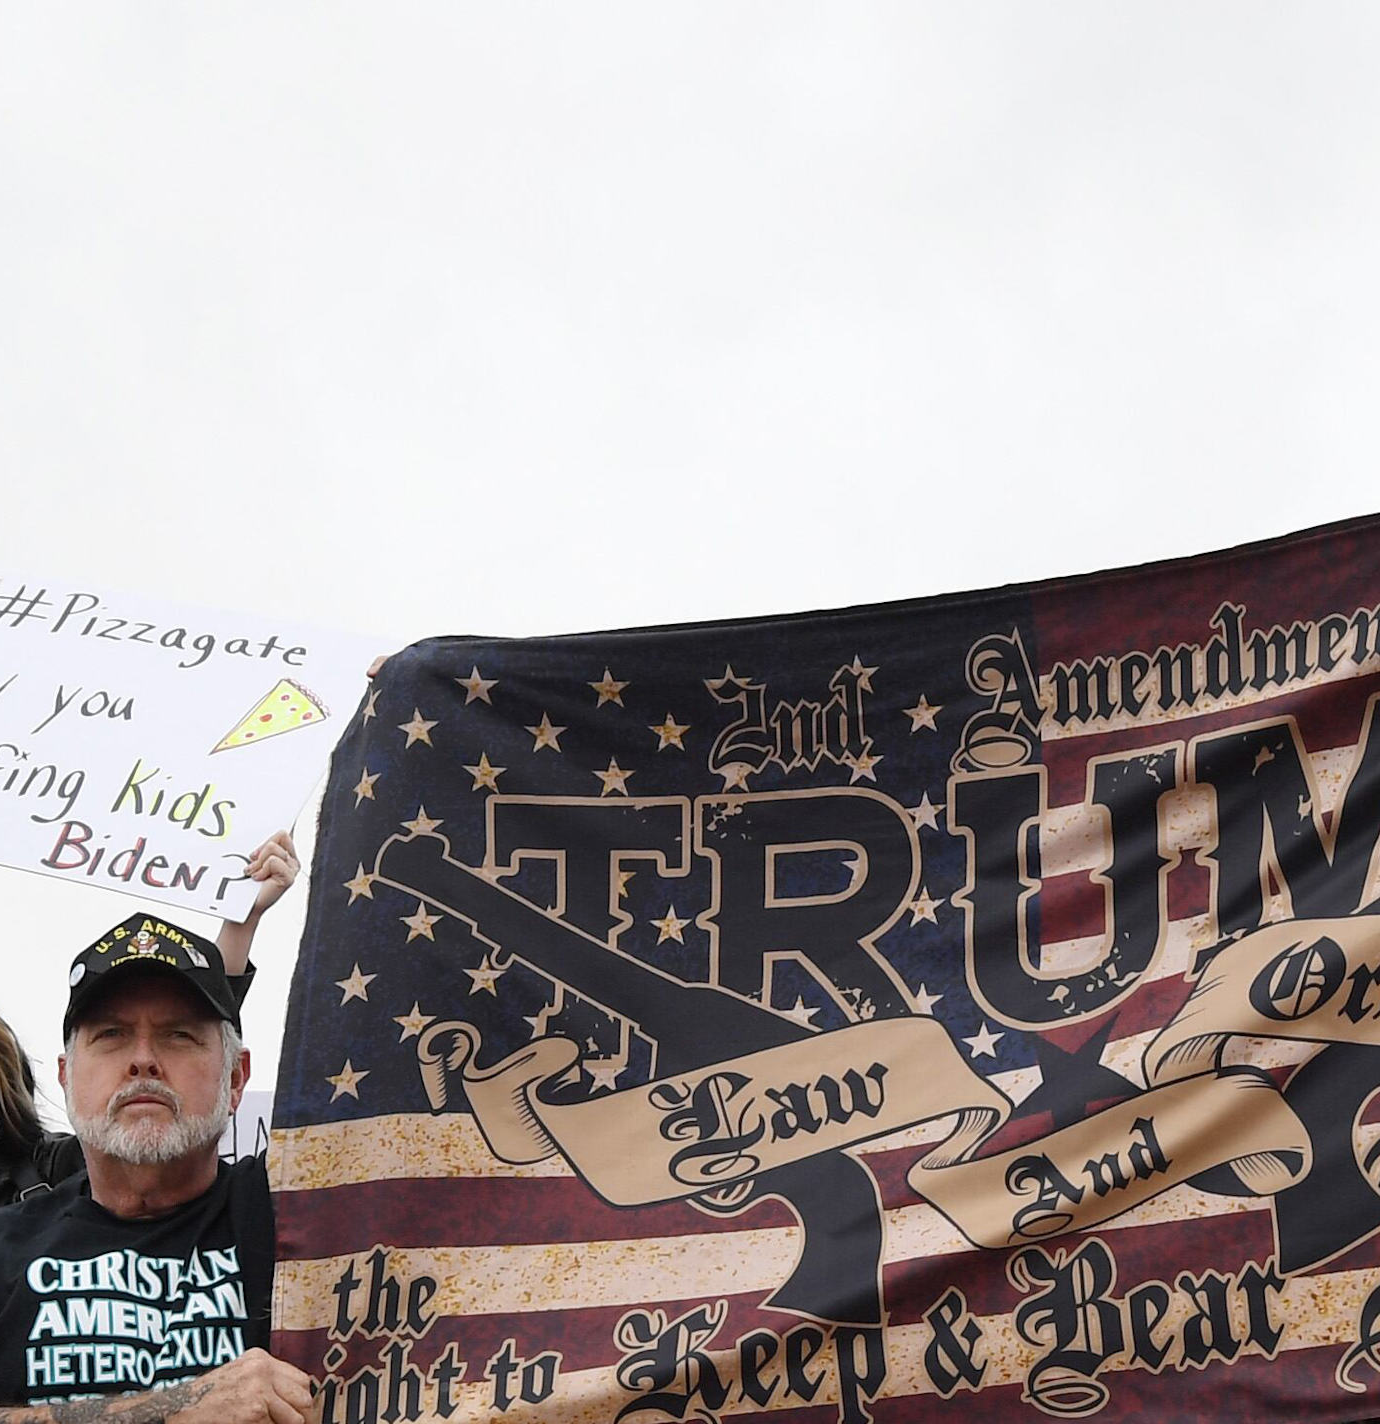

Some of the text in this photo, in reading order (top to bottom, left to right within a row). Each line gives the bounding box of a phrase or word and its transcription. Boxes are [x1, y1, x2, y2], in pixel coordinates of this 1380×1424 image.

[30, 683, 134, 734] you
[709, 660, 876, 775] 2nd
[111, 758, 236, 838] Kids
[95, 919, 194, 954] U.S. ARMY
[649, 1060, 888, 1185] Law
[1004, 1116, 1173, 1244] And
[27, 1245, 240, 1301] CHRISTAN
[28, 1281, 248, 1345] AMERAN
[331, 1247, 438, 1339] the
[488, 1341, 559, 1413] to
[923, 1287, 988, 1398] &
[1008, 1237, 1285, 1420] Bear
